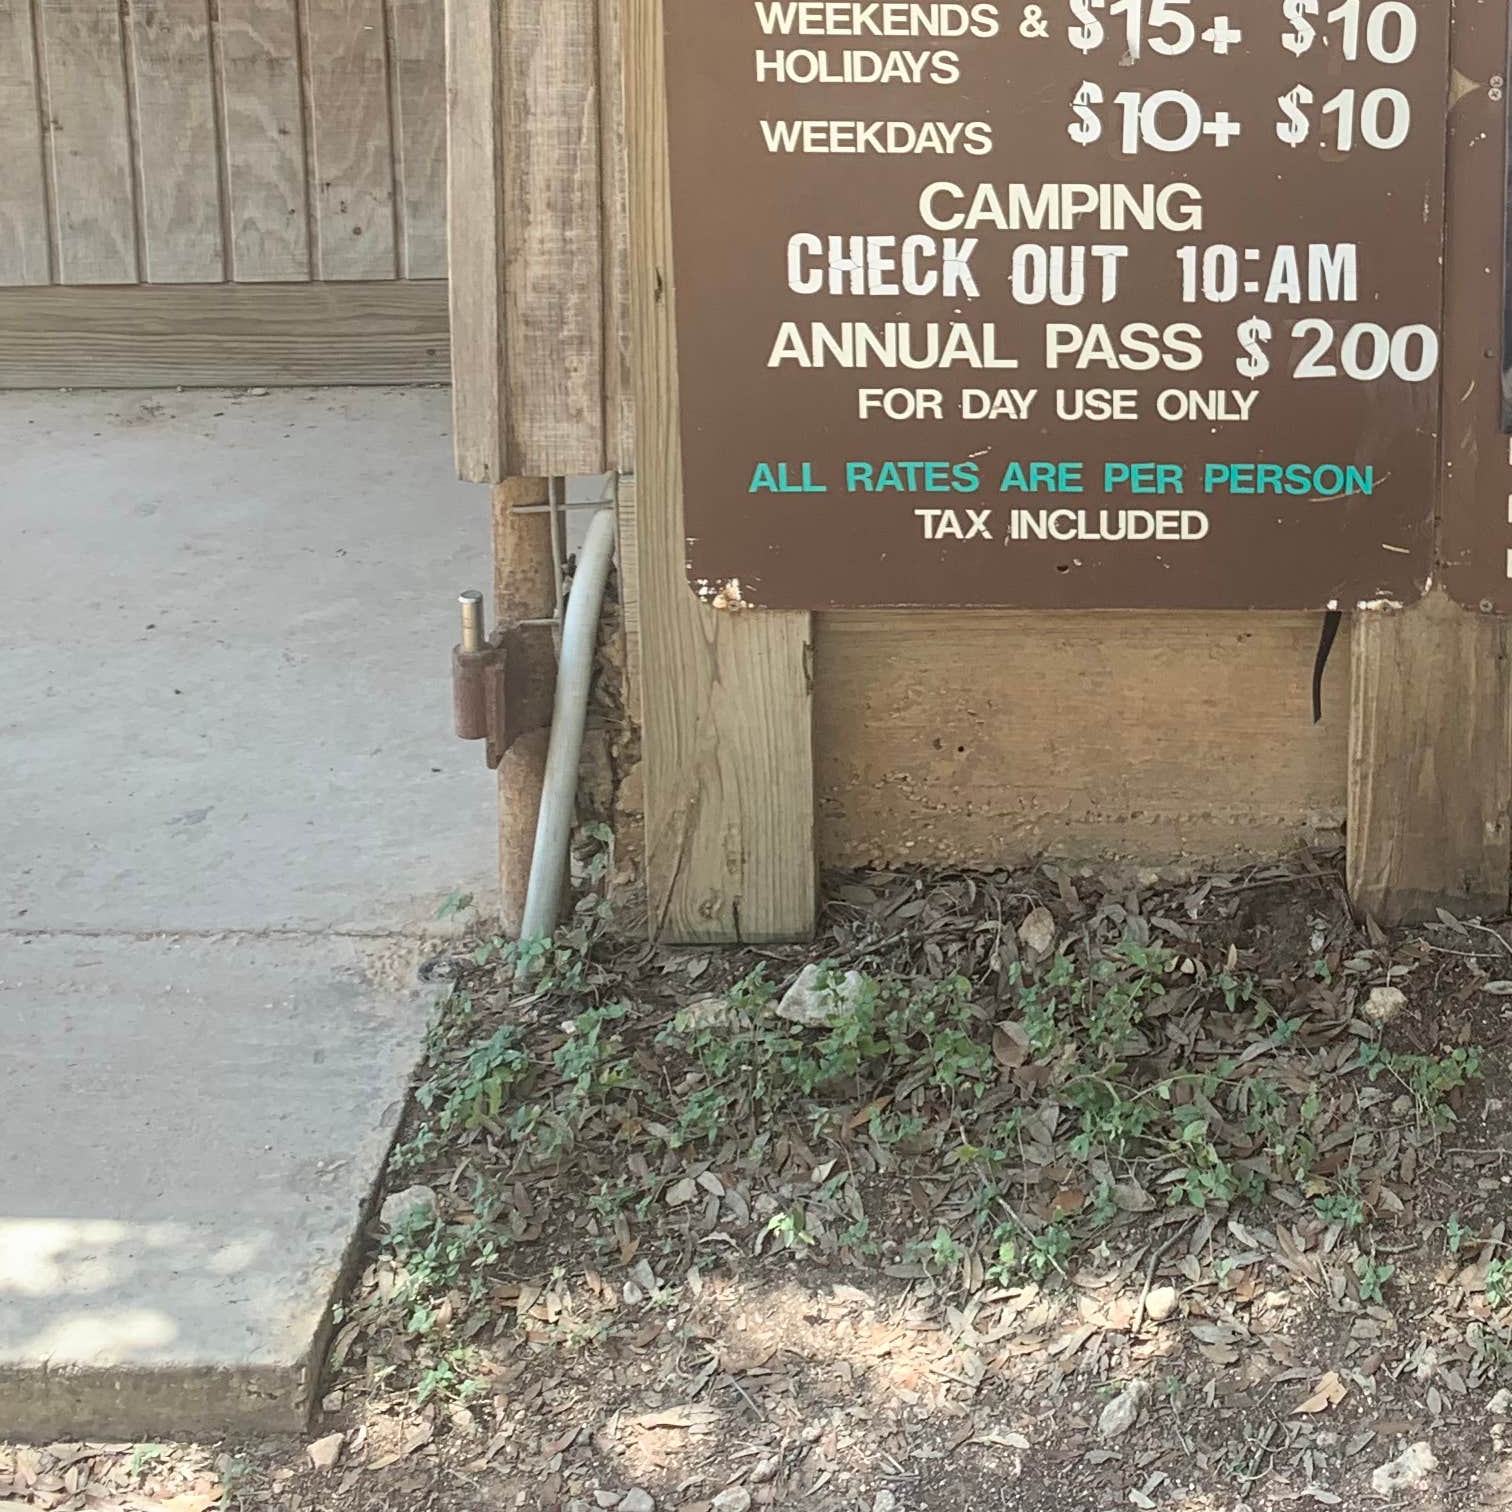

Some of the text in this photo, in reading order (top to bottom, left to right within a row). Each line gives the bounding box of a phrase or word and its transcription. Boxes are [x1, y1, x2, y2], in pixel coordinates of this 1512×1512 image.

[755, 2, 998, 37] WEEKENDS
[1020, 5, 1048, 37] &
[756, 50, 959, 84] HOLIDAYS
[760, 121, 992, 155] WEEKDAYS
[1277, 85, 1409, 151] $10
[920, 182, 1201, 231] CAMPING
[788, 233, 1356, 305] CHECK OUT 10:AM
[768, 322, 1017, 368] ANNUAL
[1047, 323, 1202, 370] PASS
[859, 388, 1258, 420] FOR DAY USE ONLY
[750, 462, 1373, 495] ALL RATES ARE PER PERSON
[915, 510, 1208, 540] TAX INCLUDED
